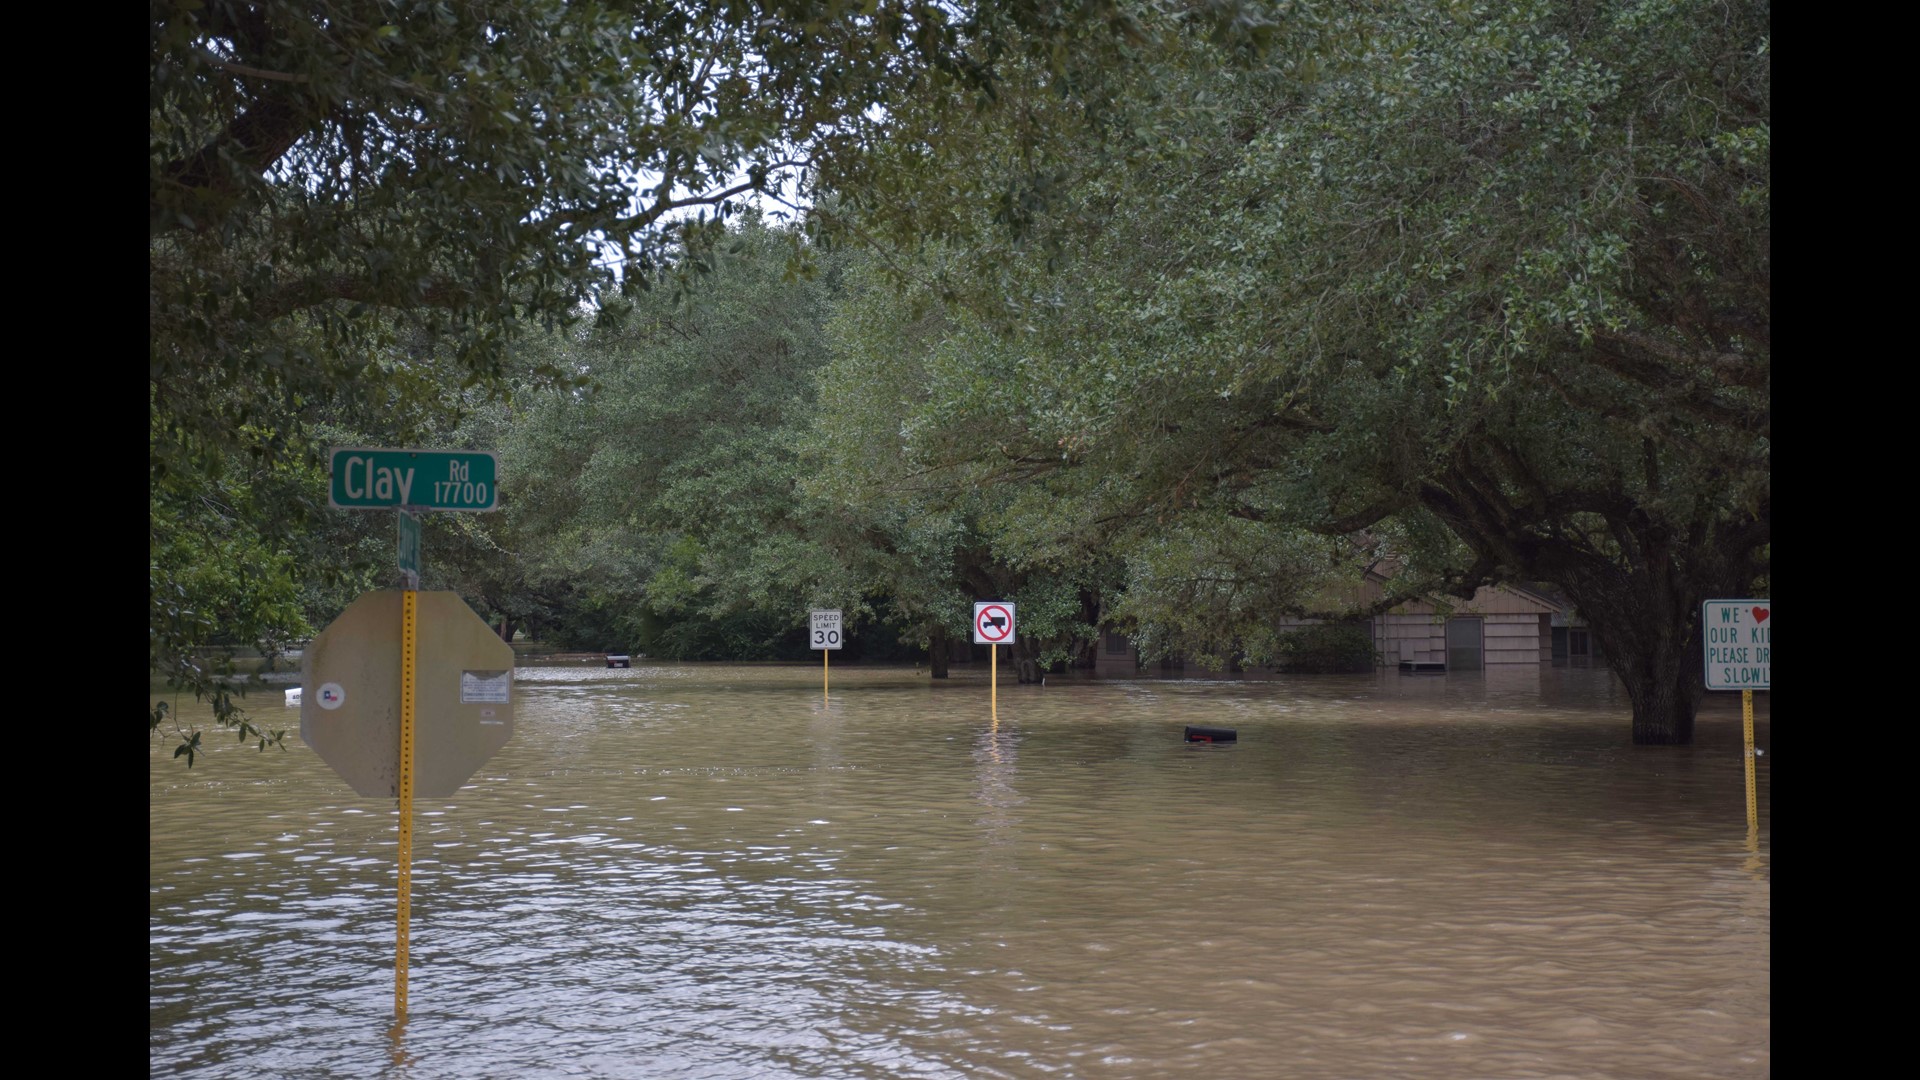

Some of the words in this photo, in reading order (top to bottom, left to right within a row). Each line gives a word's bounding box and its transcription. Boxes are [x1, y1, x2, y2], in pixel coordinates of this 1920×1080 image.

[344, 456, 415, 505] Clay
[450, 460, 469, 482] Rd
[434, 481, 487, 504] 17700
[1721, 607, 1740, 623] WE
[814, 630, 839, 644] 30
[1710, 627, 1737, 643] OUR
[1752, 627, 1770, 643] KI
[1710, 647, 1749, 663] PLEASE
[1724, 667, 1770, 683] SLOWL
